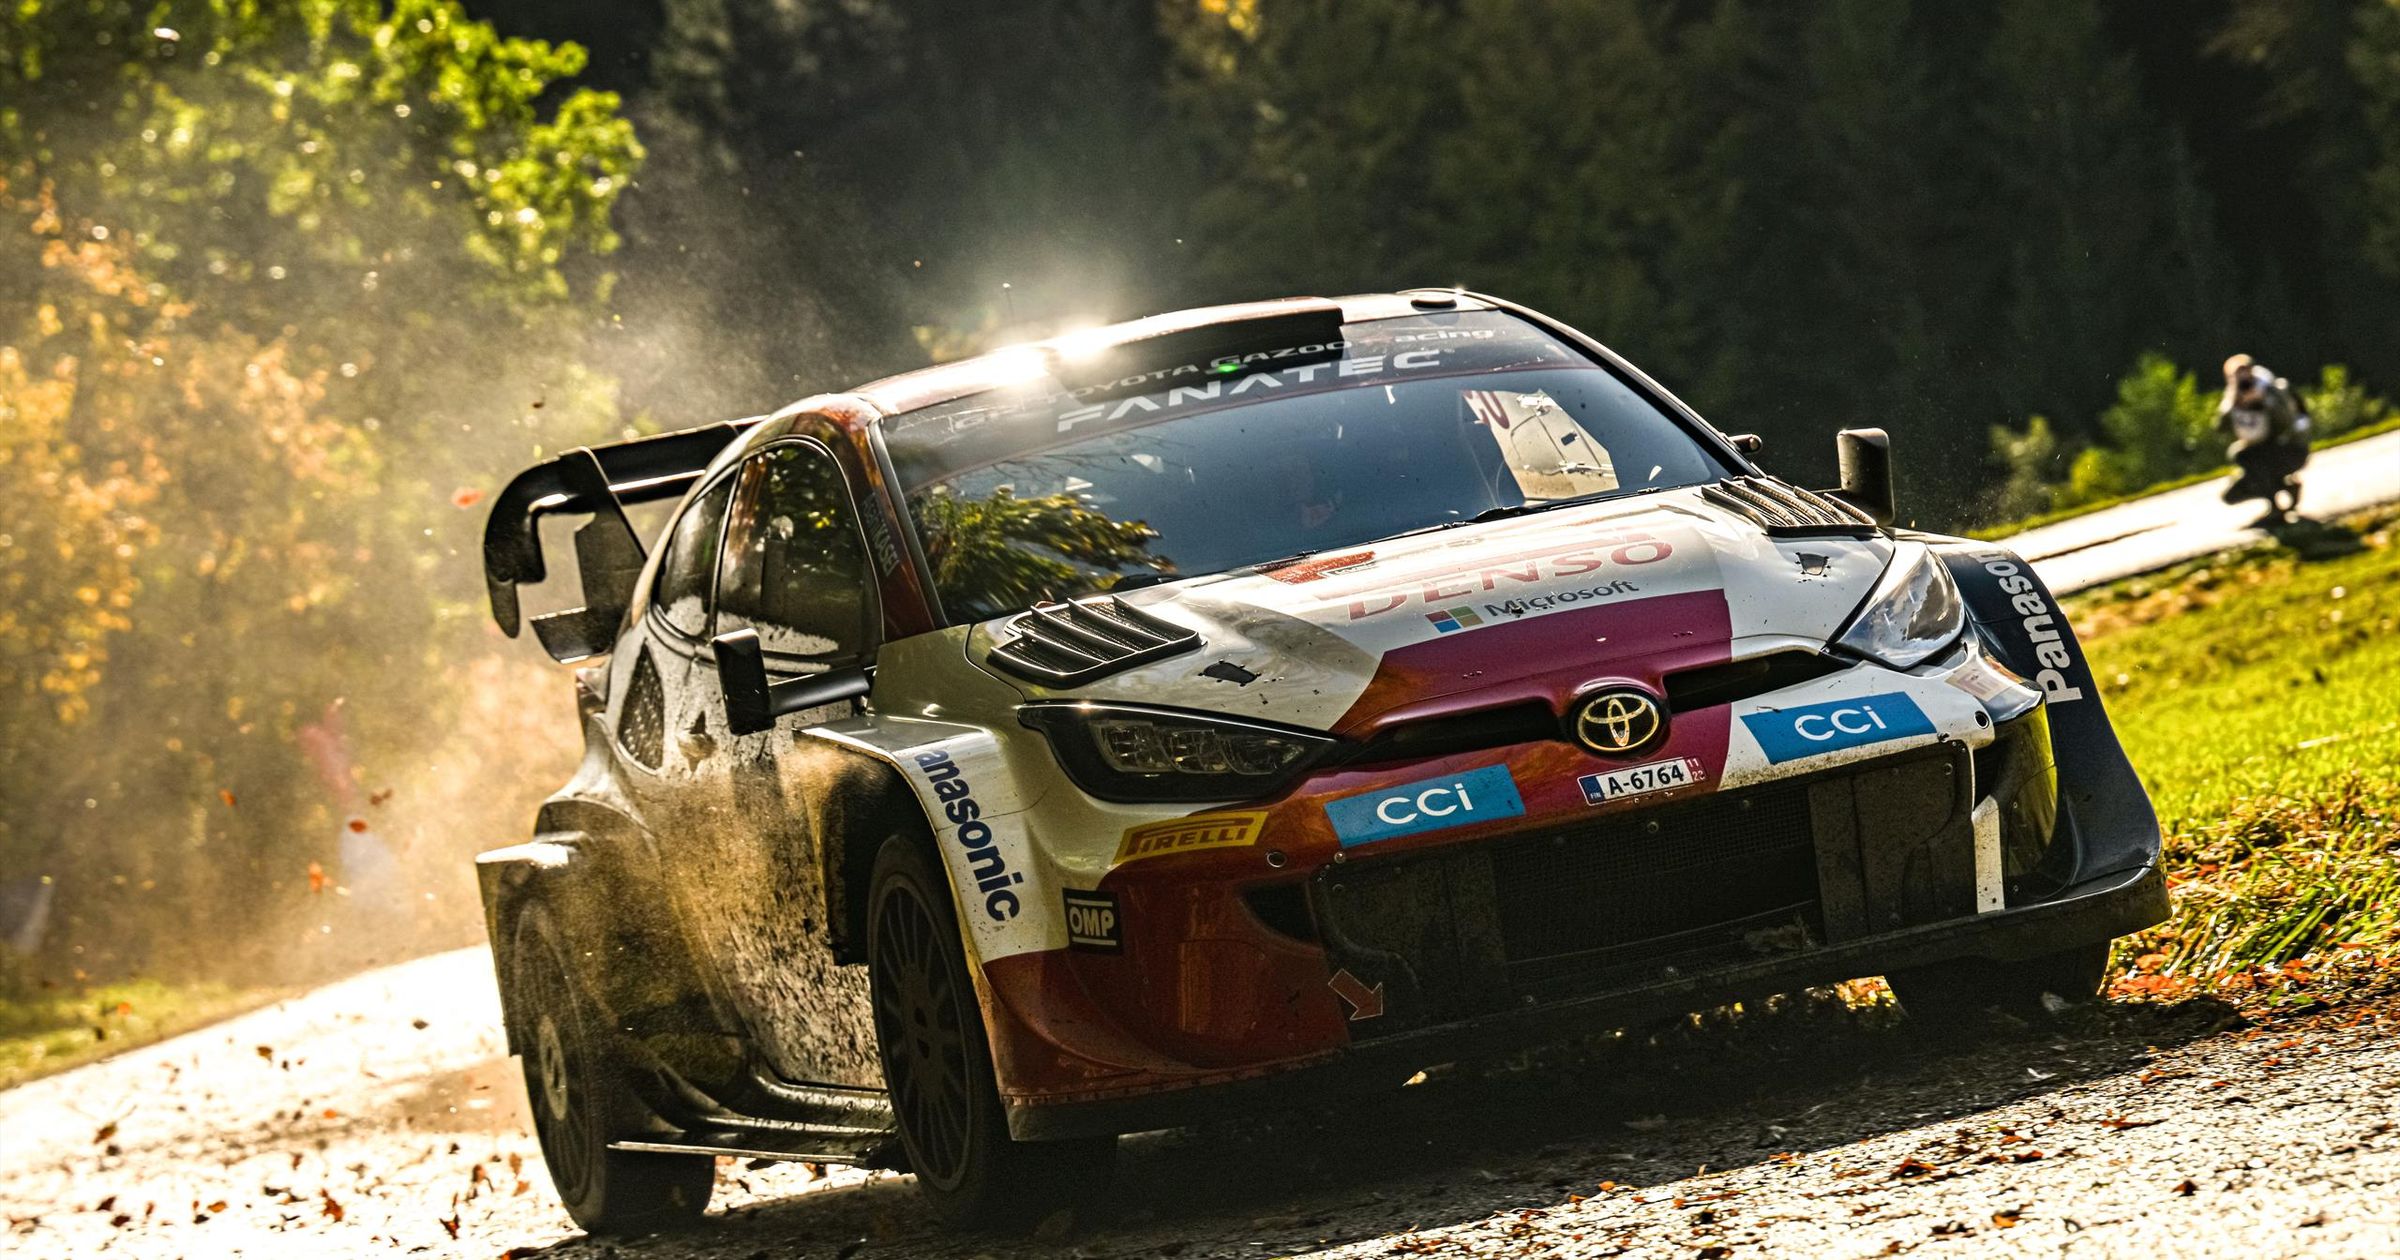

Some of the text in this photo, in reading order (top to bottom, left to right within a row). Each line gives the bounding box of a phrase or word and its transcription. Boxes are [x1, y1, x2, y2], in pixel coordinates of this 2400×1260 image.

[1210, 340, 1353, 369] GAZOO
[1359, 328, 1496, 345] acing
[1056, 349, 1442, 433] FANATEC
[1348, 541, 1673, 621] DENSO
[1483, 579, 1640, 618] Microsoft
[1607, 764, 1685, 796] A-6764
[1686, 758, 1700, 768] 11
[1123, 816, 1256, 858] PIRELLI
[1068, 905, 1116, 938] OMP
